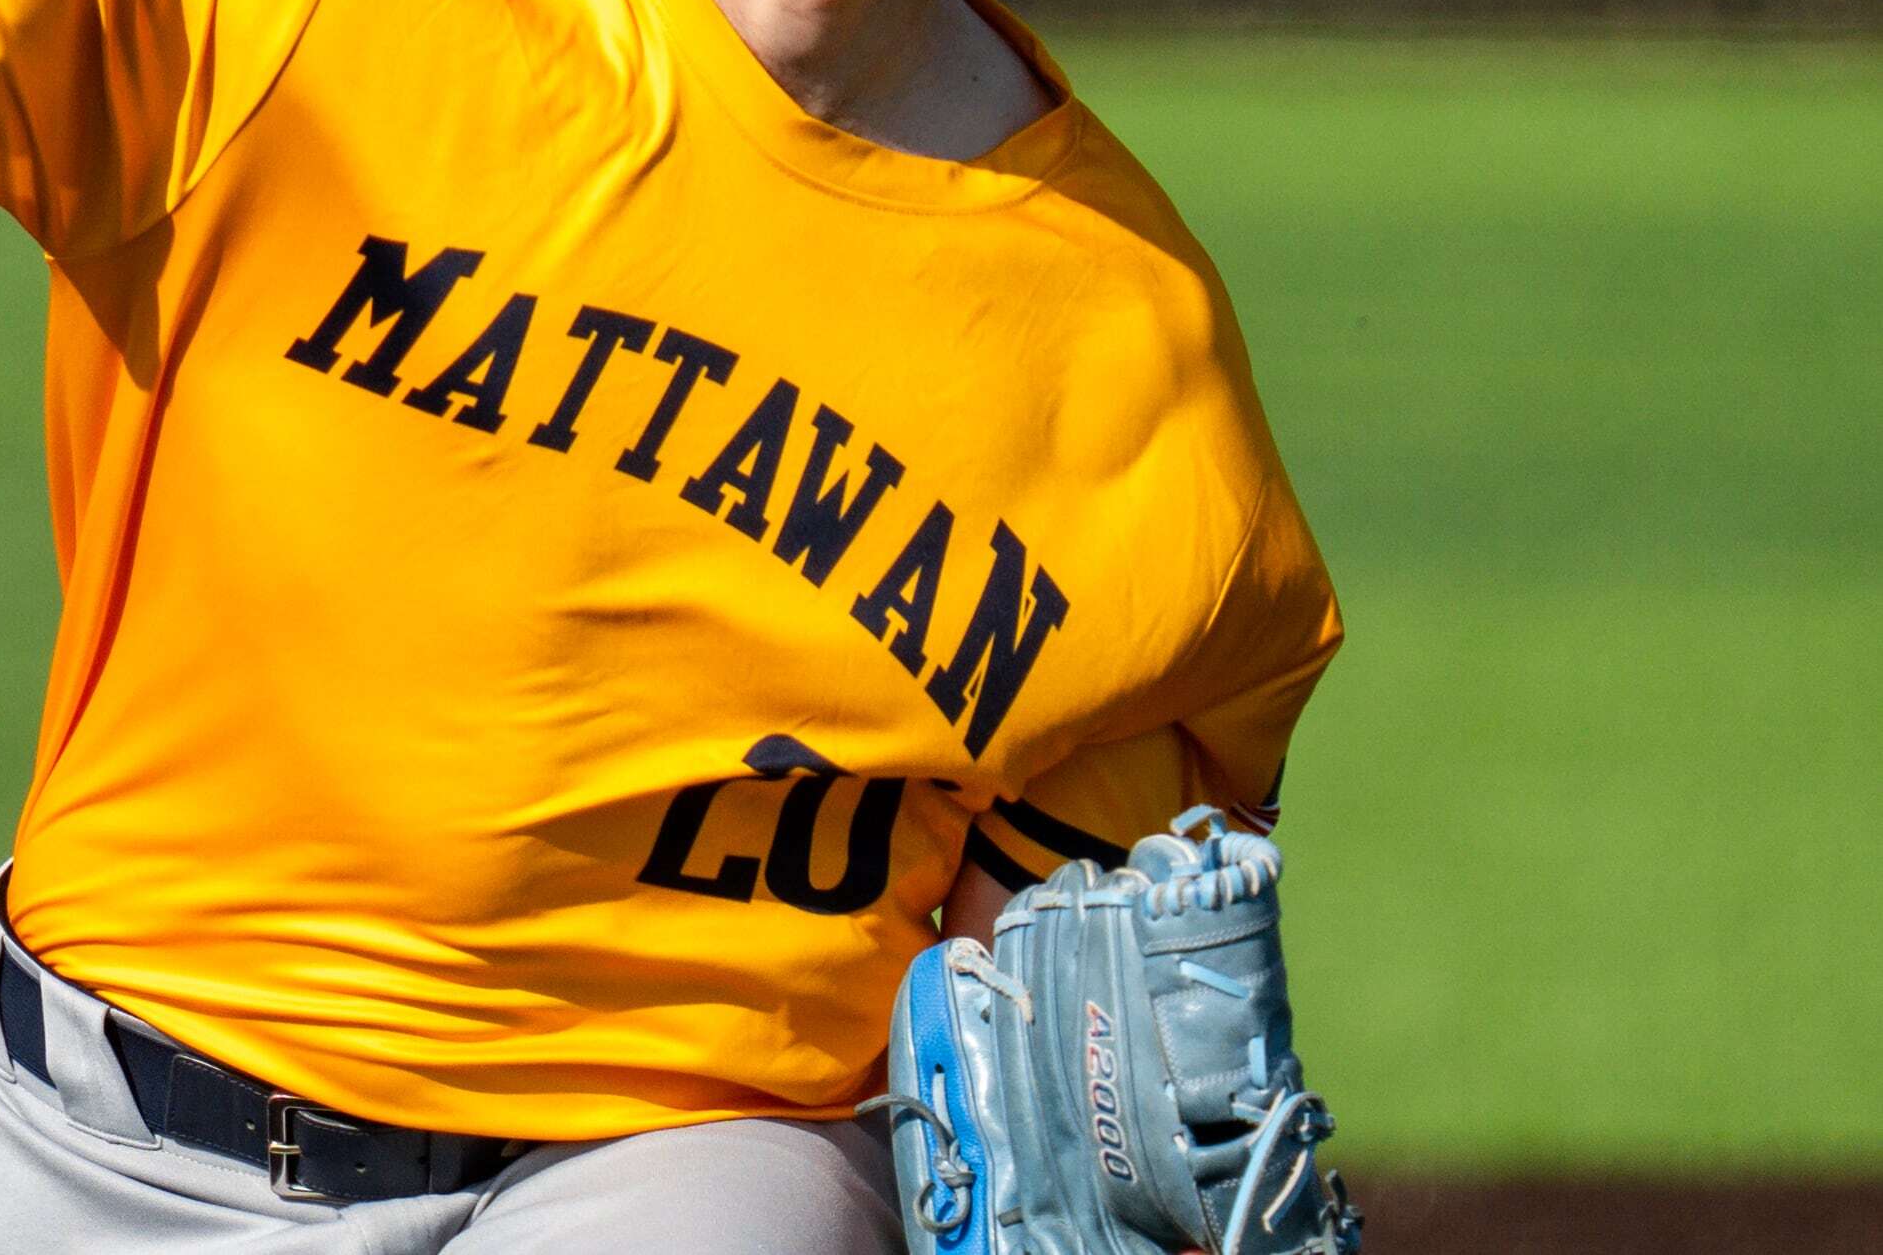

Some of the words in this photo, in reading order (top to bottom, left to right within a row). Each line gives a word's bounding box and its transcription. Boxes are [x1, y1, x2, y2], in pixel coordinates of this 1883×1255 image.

[284, 234, 1070, 758] MATTAWAN
[636, 734, 906, 914] 20
[1086, 1001, 1138, 1183] A2000
